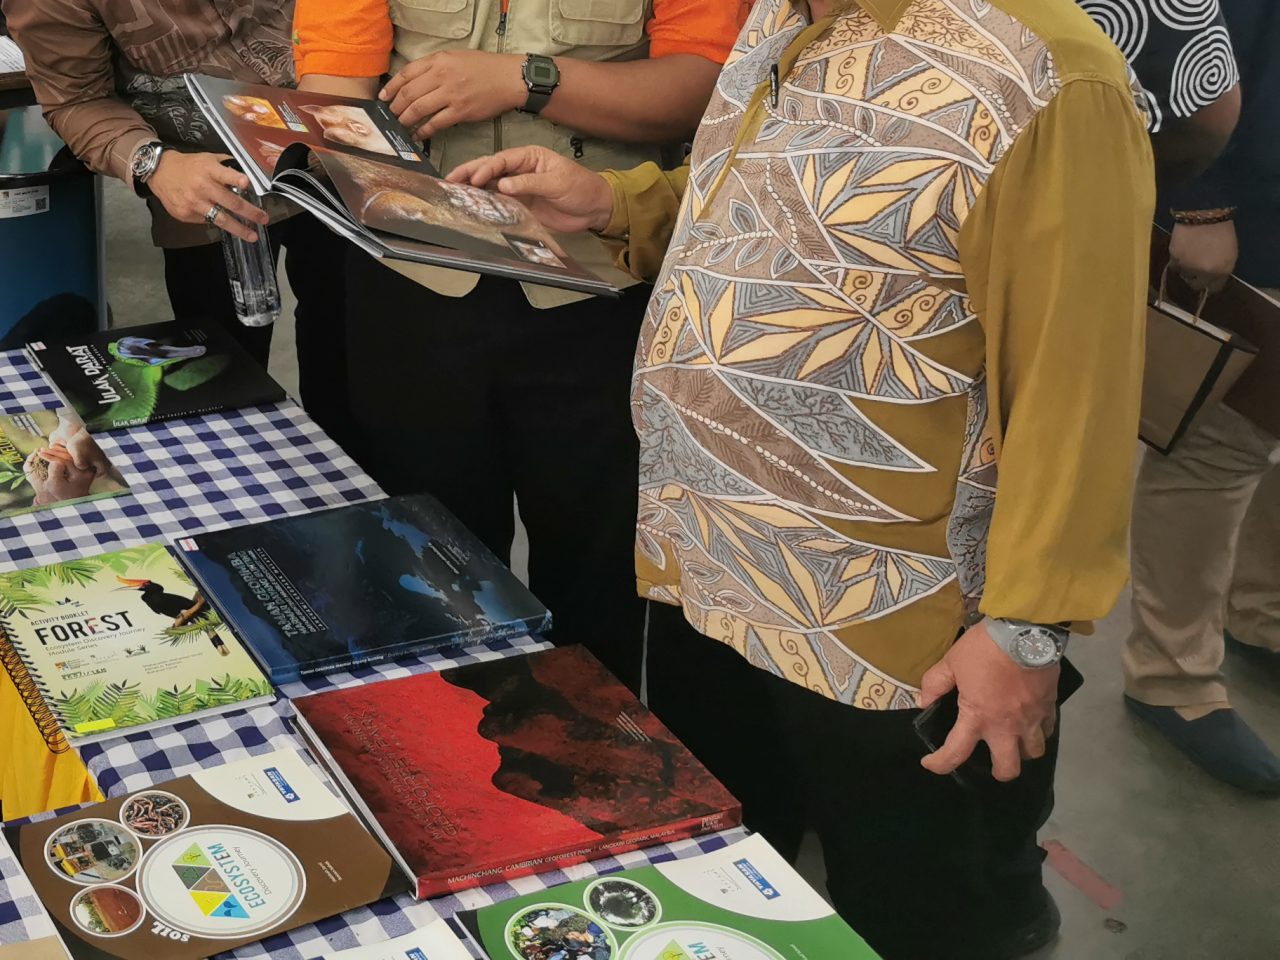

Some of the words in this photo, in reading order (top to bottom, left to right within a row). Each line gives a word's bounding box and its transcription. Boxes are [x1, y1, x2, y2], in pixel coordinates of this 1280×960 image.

[30, 616, 59, 626] ACTIVITY
[60, 611, 89, 621] BOOKLET
[34, 611, 133, 645] FOREST
[262, 600, 298, 637] TAMAN
[208, 843, 266, 909] ECOSYSTEM
[246, 864, 273, 896] Discovery
[448, 867, 503, 884] MACHINCHANG
[505, 859, 543, 873] CAMBRIAN
[151, 922, 190, 942] SOIL
